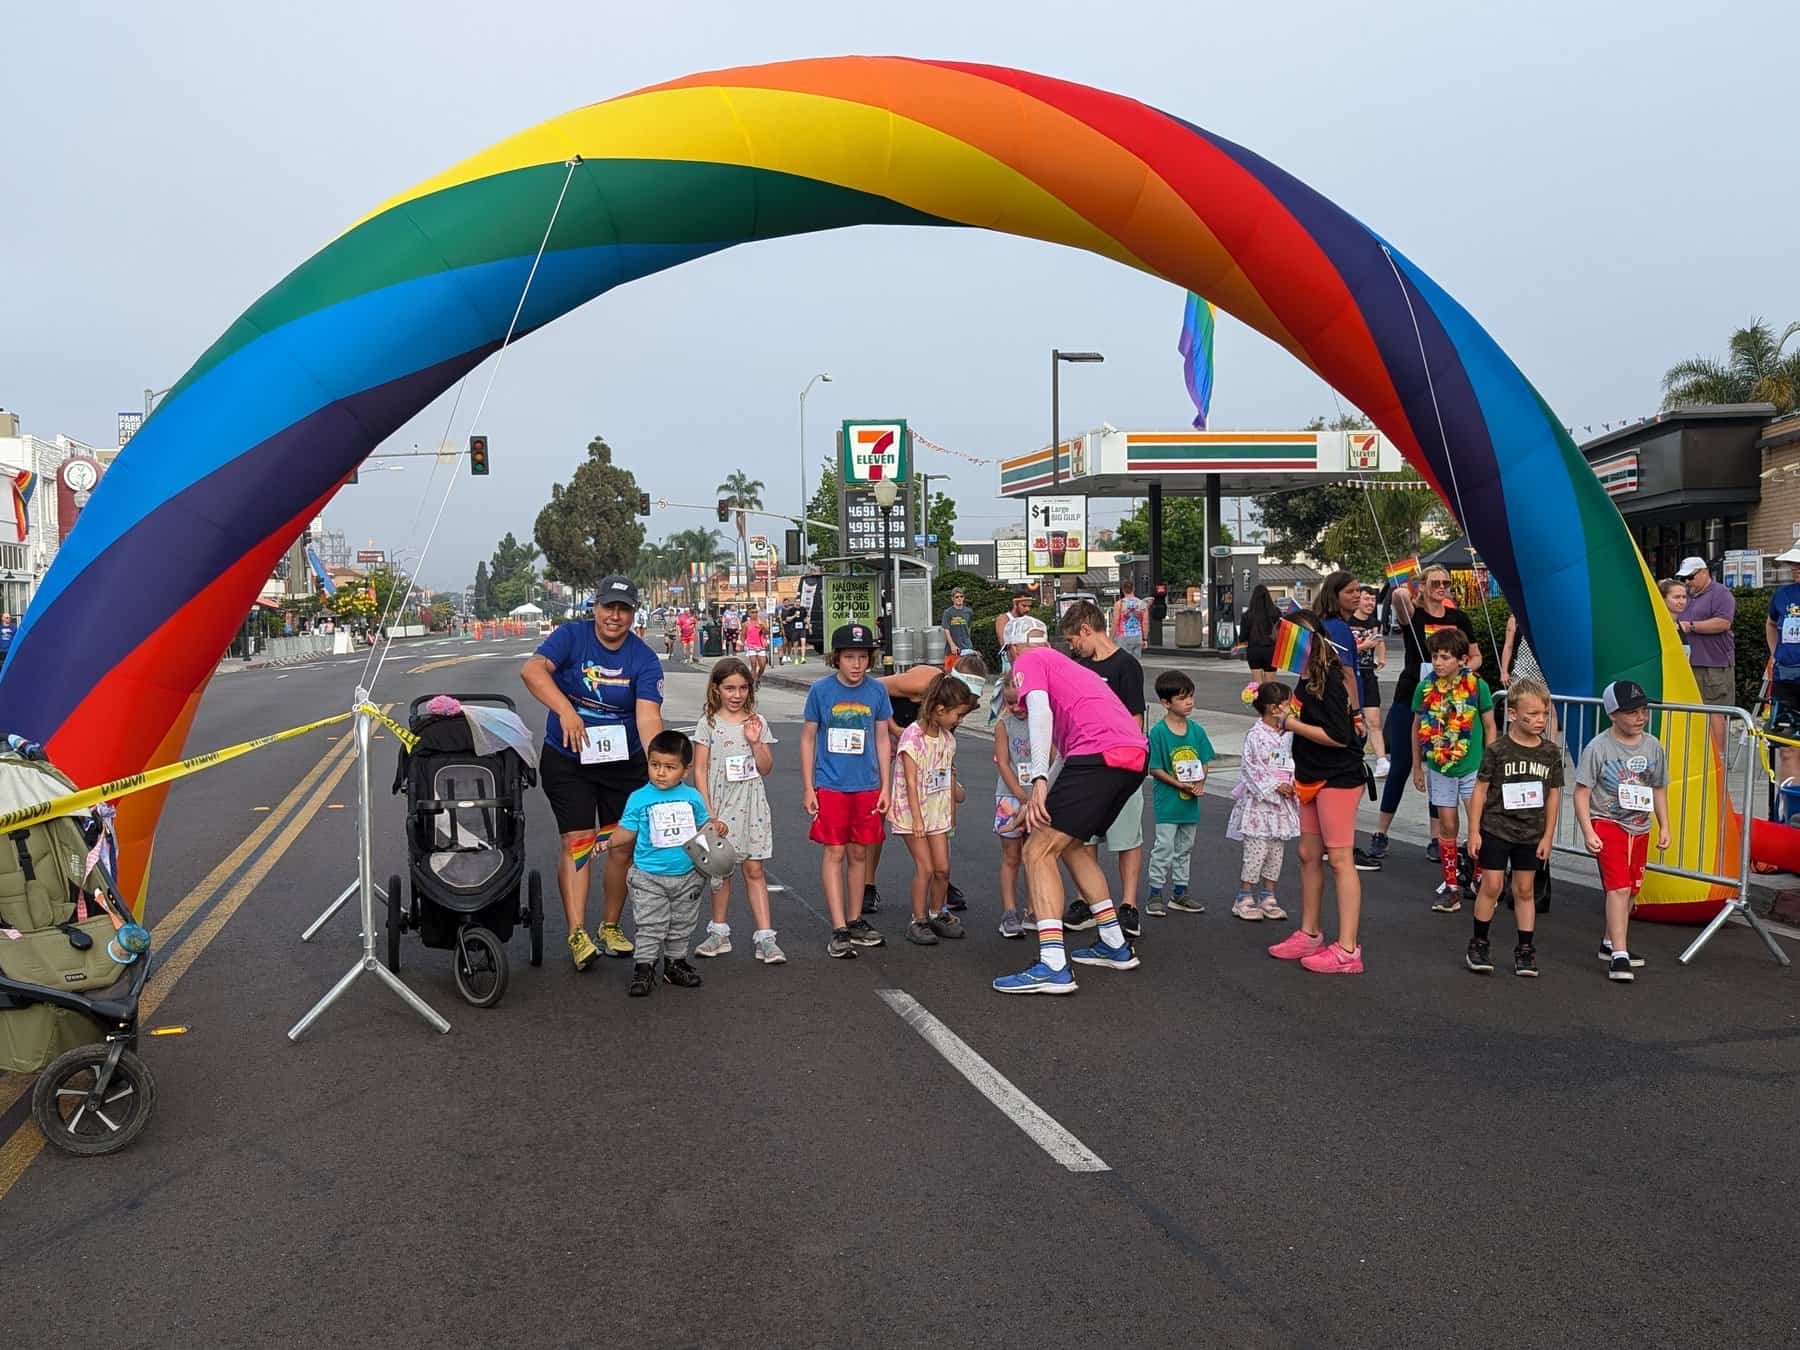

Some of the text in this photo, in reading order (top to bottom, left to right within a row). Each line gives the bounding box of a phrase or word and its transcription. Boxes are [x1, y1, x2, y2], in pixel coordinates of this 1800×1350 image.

[120, 415, 142, 423] PARK
[857, 430, 894, 480] 7
[833, 601, 870, 611] OPIOID
[596, 739, 611, 752] 19
[1504, 760, 1550, 780] OLD NAVY
